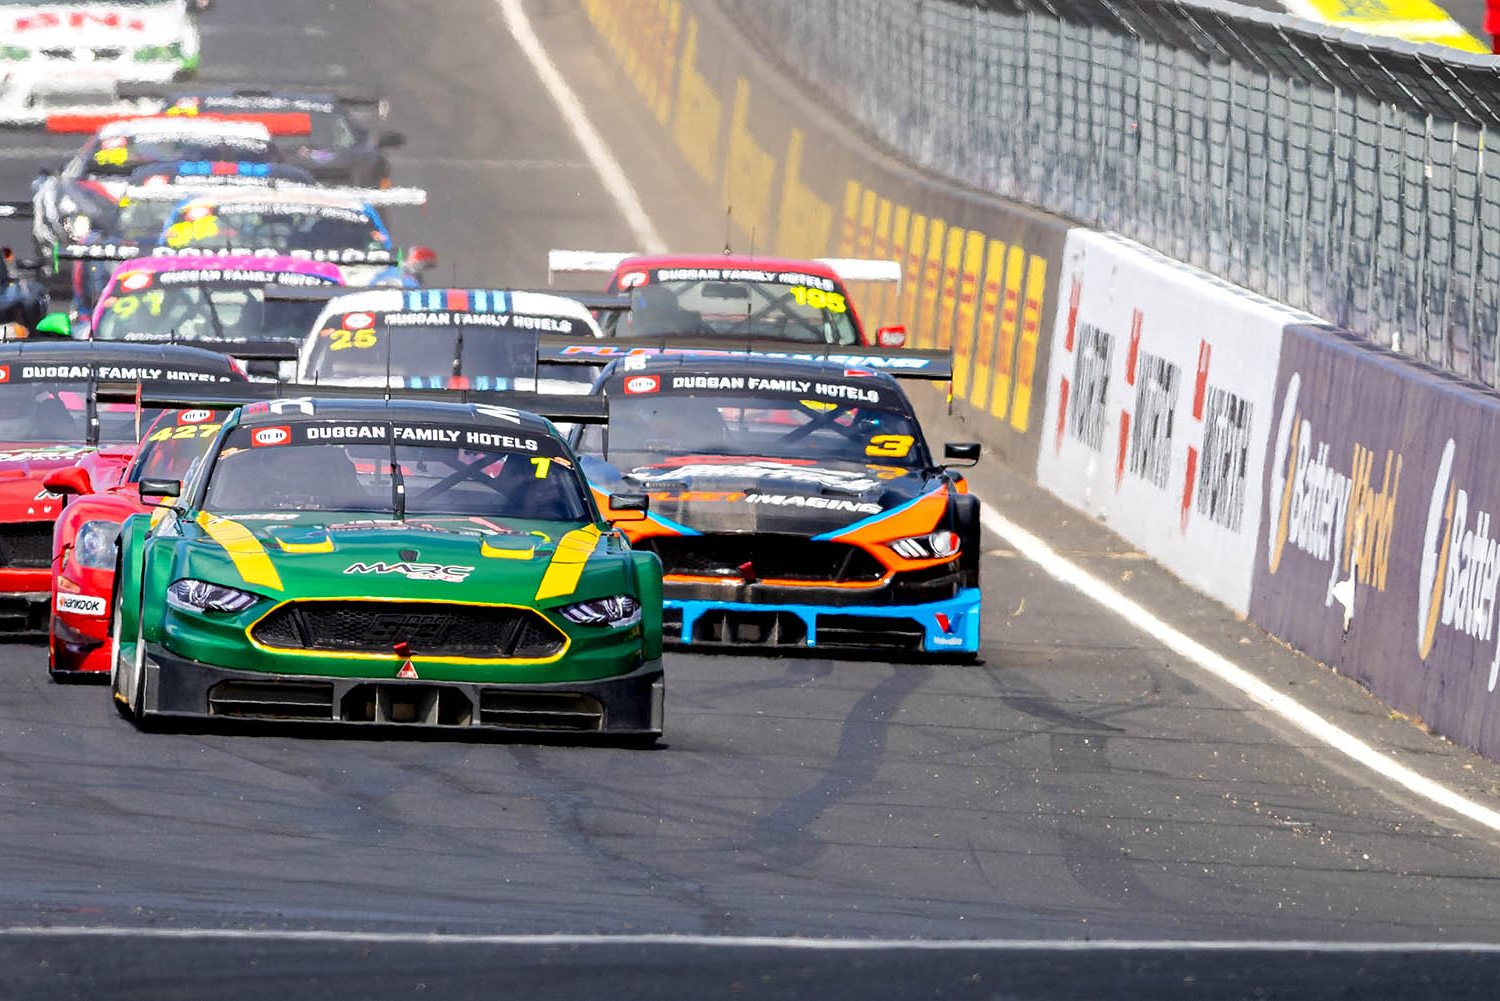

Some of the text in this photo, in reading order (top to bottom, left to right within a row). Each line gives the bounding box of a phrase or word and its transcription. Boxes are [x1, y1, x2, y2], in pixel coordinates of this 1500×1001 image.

[329, 328, 377, 351] 25
[22, 367, 91, 379] DUGGAN
[97, 367, 162, 380] FAMILY
[673, 376, 744, 390] DUGGAN
[748, 377, 812, 394] FAMILY
[815, 381, 879, 403] HOTELS
[148, 424, 222, 442] 427
[306, 427, 386, 440] DUGGAN
[394, 427, 461, 443] FAMILY
[467, 430, 539, 451] HOTELS
[865, 434, 915, 458] 3
[530, 457, 550, 479] 1
[745, 494, 883, 515] IMAGING
